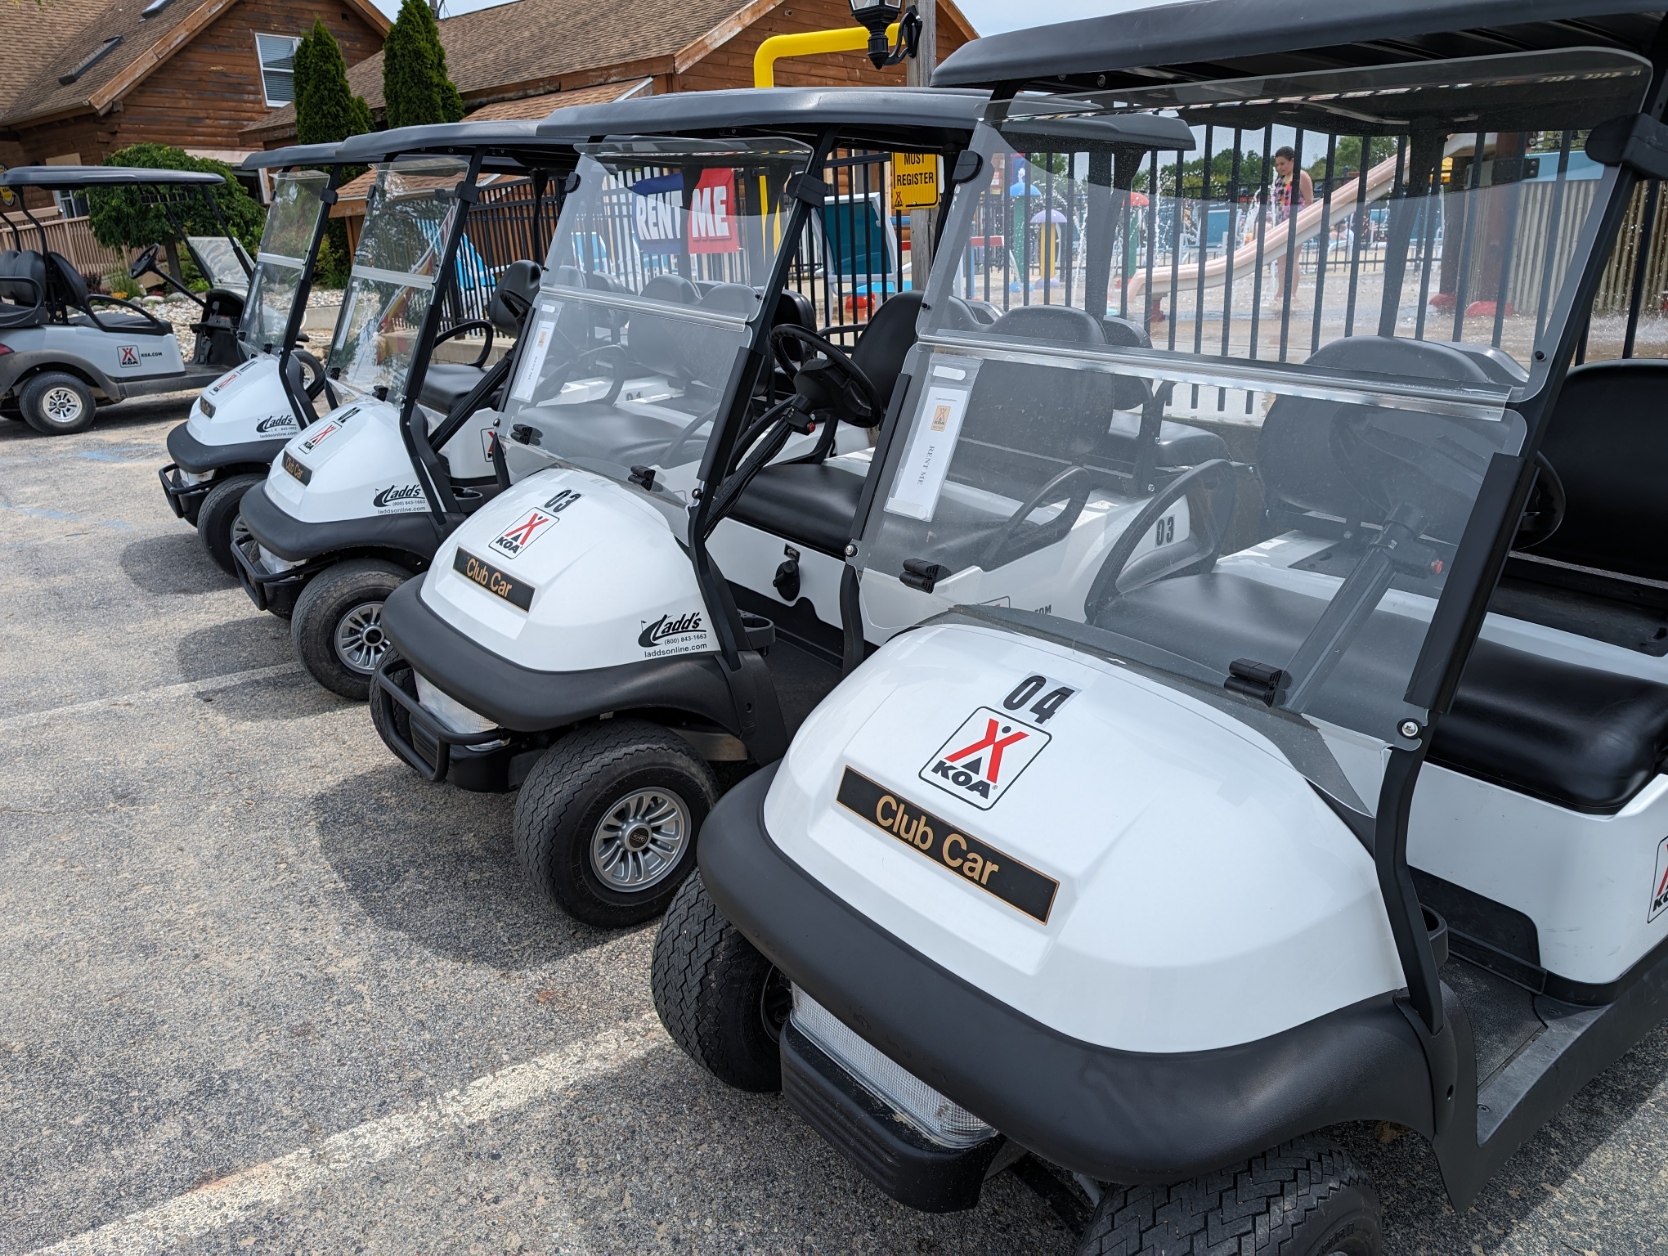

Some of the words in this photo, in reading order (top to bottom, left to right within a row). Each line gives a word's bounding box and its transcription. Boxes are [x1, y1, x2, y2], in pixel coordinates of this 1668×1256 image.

[904, 153, 925, 165] MUST
[897, 172, 934, 186] REGISTER
[635, 190, 684, 240] RENT
[691, 185, 730, 238] ME
[922, 445, 936, 469] RENT
[294, 463, 304, 480] Car
[917, 470, 928, 486] ME
[383, 484, 422, 503] Ladd's
[544, 489, 582, 513] 03
[1155, 515, 1176, 547] 03
[495, 536, 521, 554] KOA
[466, 558, 489, 586] Club
[490, 571, 513, 598] Car
[650, 611, 703, 642] Ladd's
[644, 643, 707, 657] laddsonline.com
[664, 637, 680, 646] (800)
[680, 634, 707, 642] 843-1663
[1002, 674, 1075, 725] 04
[931, 760, 990, 801] KOA
[875, 795, 935, 851] Club
[941, 833, 1000, 886] Car
